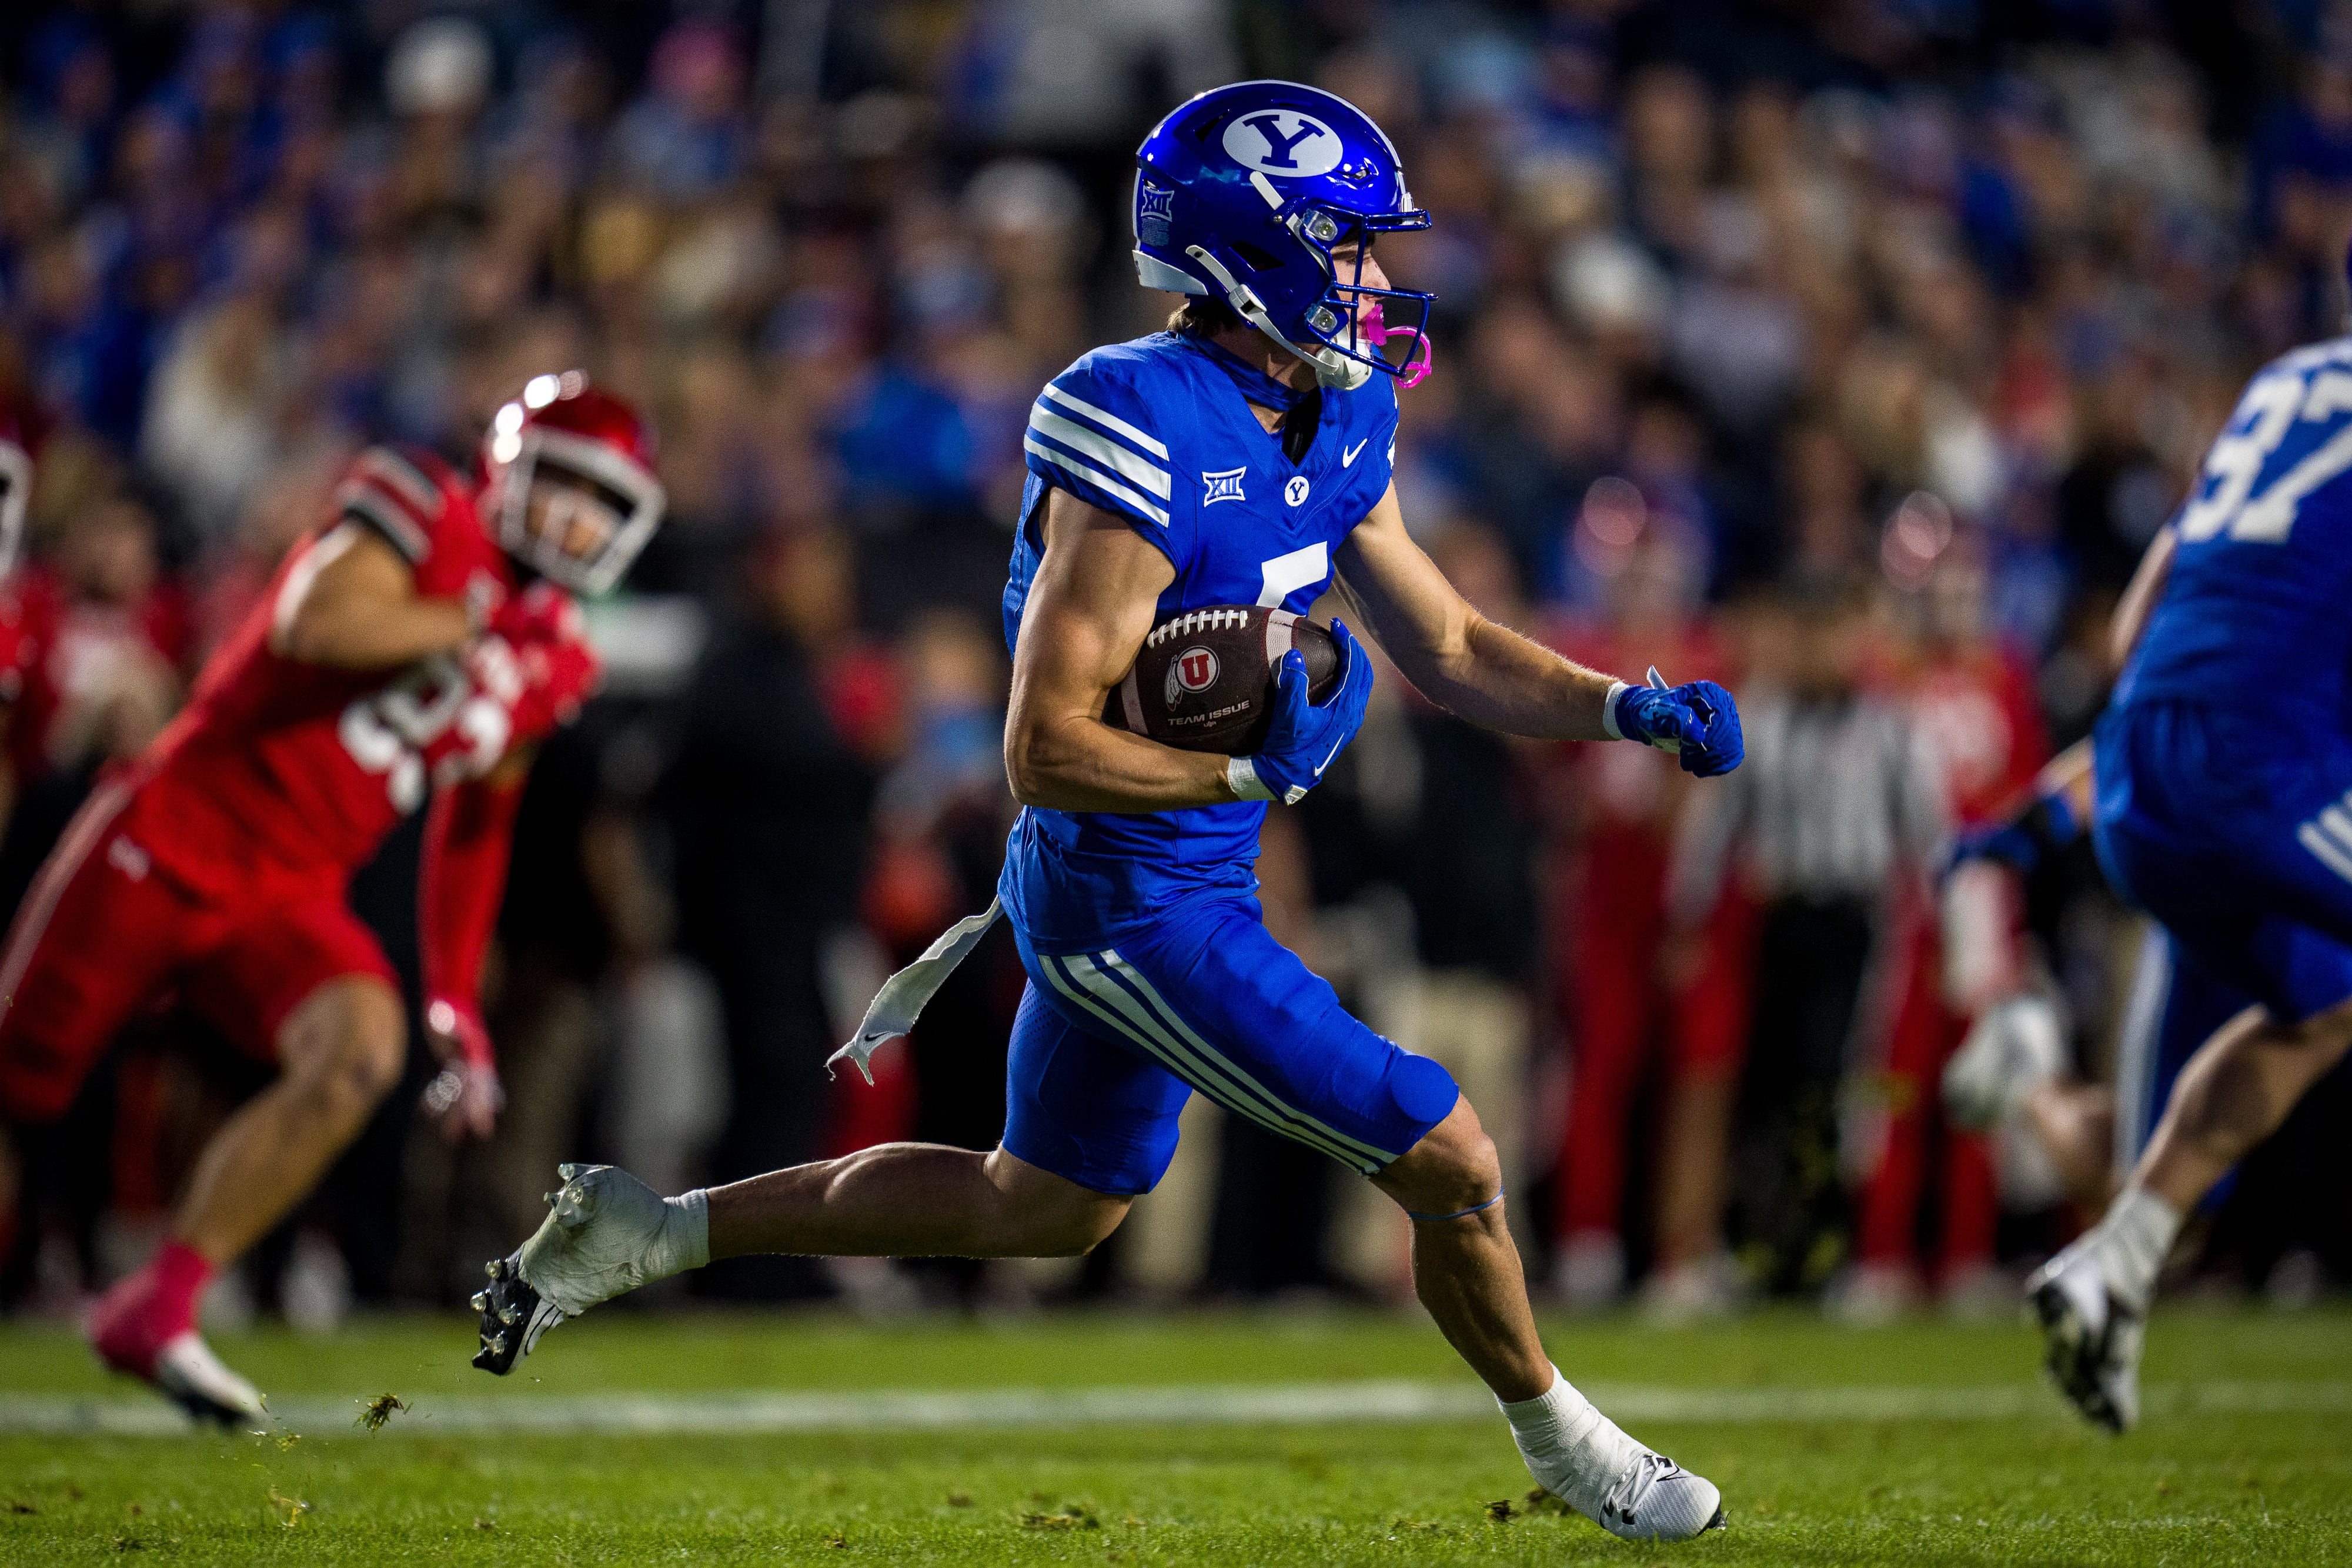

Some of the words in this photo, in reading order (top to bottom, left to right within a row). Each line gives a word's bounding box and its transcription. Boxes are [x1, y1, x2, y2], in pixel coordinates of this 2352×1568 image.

[1242, 115, 1325, 169] Y
[2178, 370, 2352, 544] 37
[1204, 469, 1245, 504] XII
[1289, 480, 1305, 502] Y
[1181, 653, 1210, 687] U
[1168, 714, 1205, 726] TEAM
[1209, 700, 1250, 720] ISSUE
